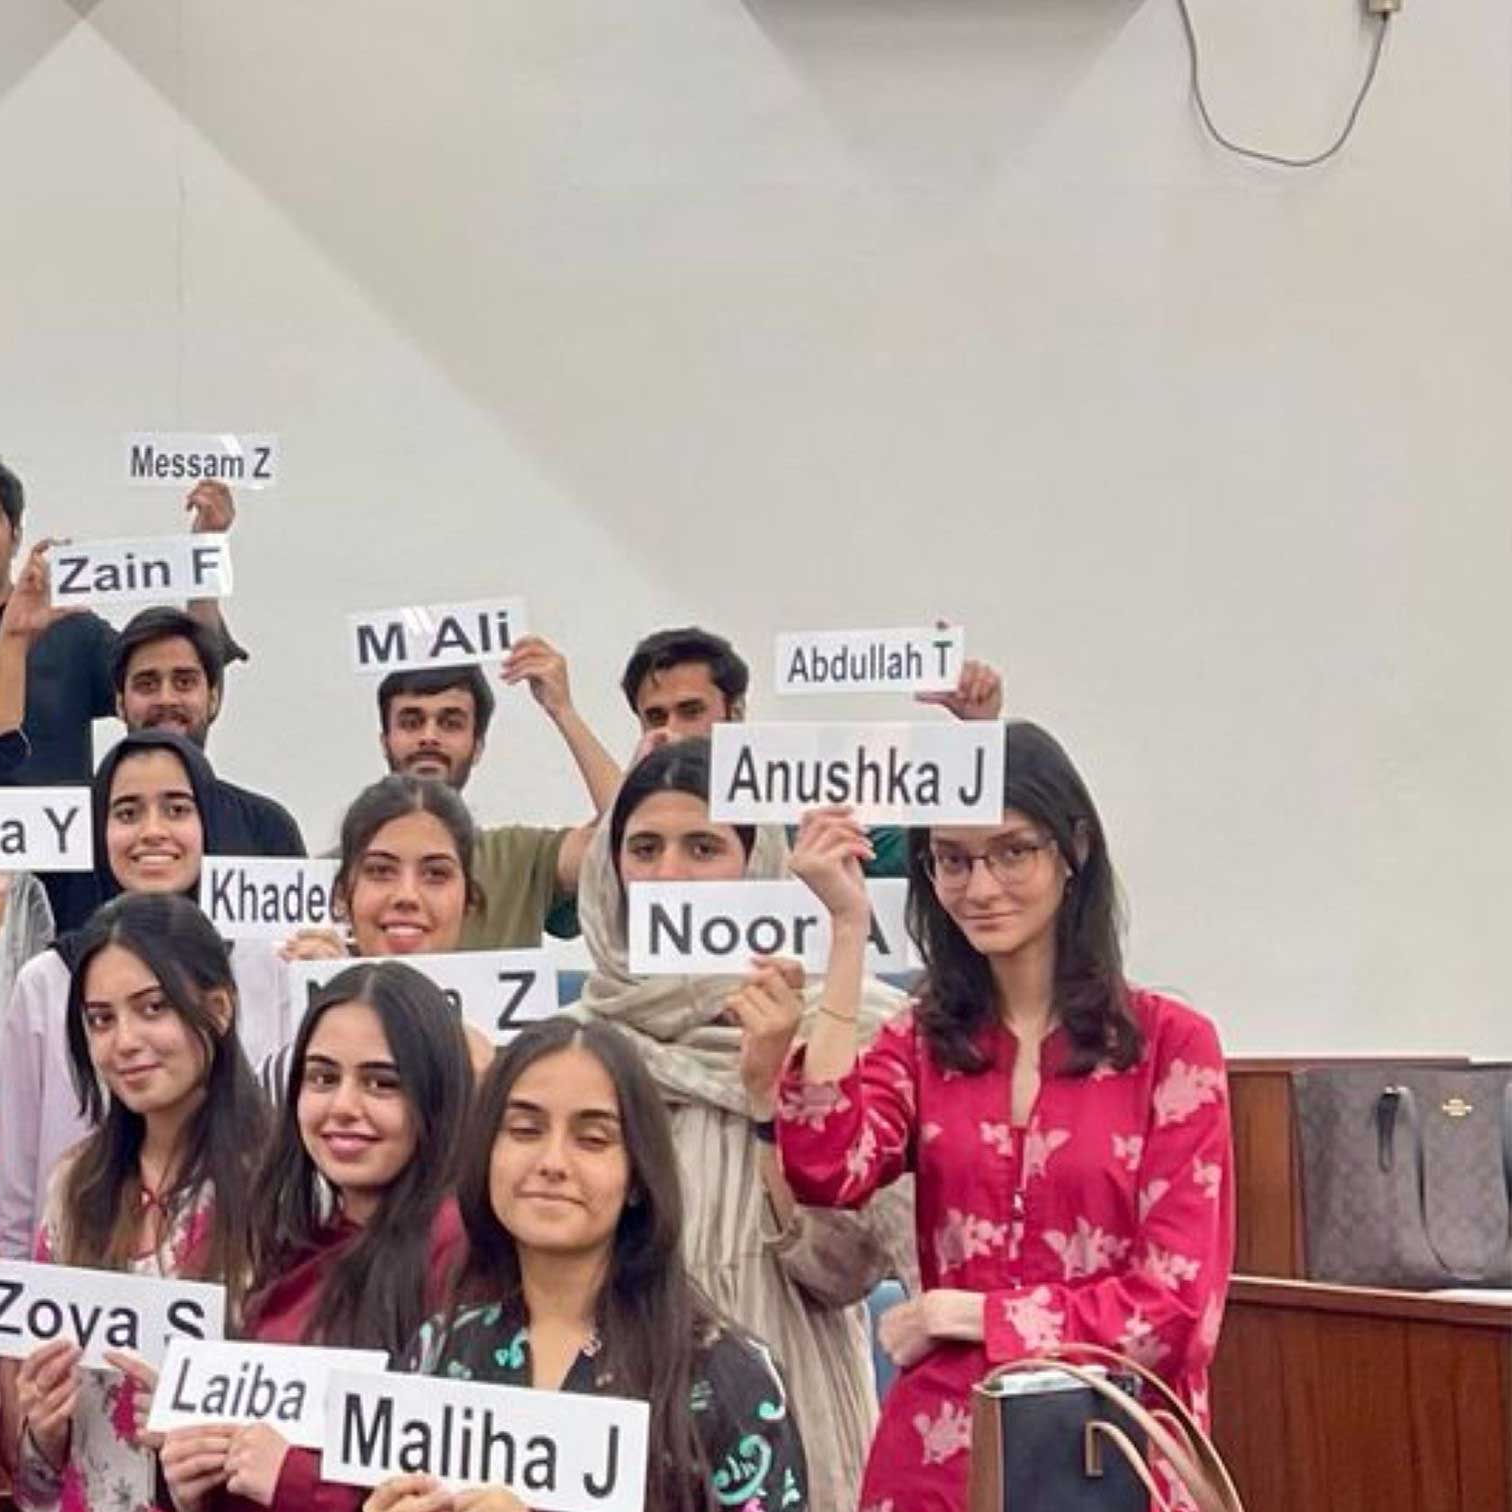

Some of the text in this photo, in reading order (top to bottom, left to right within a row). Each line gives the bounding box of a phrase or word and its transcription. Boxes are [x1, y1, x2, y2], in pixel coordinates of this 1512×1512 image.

[130, 445, 271, 482] Messam Z
[58, 548, 220, 595] Zain F
[356, 611, 514, 665] M Ali
[787, 640, 953, 683] Abdullah T
[727, 745, 984, 807] Anushka J
[43, 807, 79, 854] Y
[649, 903, 818, 956] Noor
[497, 971, 537, 1030] Z
[165, 1299, 206, 1345] S
[171, 1358, 307, 1421] Laiba
[341, 1393, 619, 1499] Maliha J
